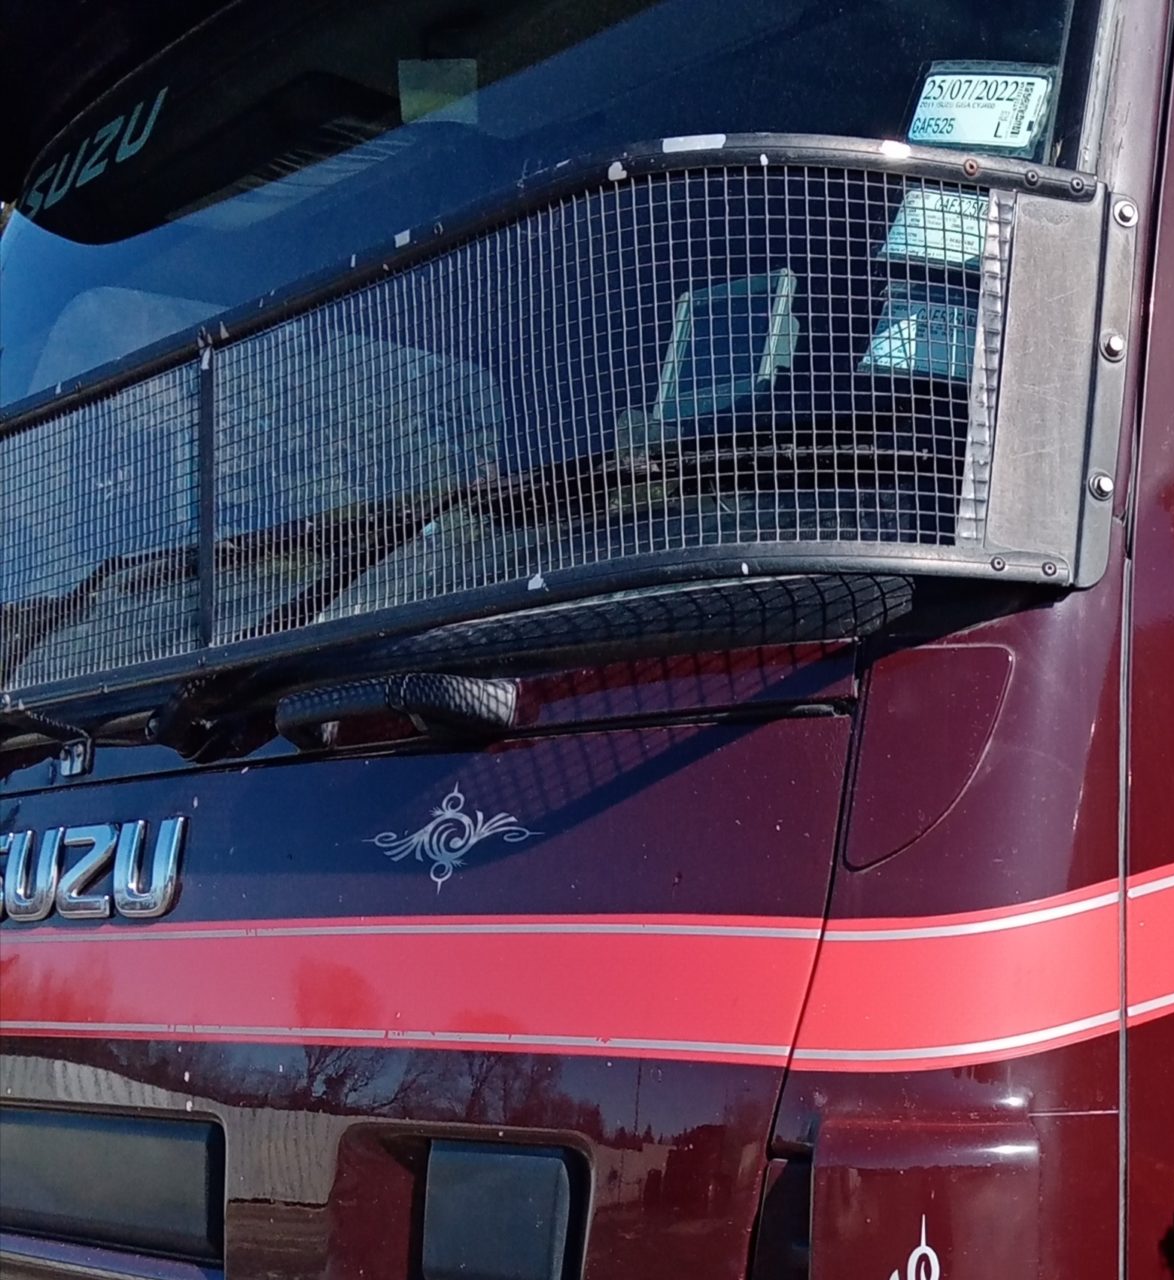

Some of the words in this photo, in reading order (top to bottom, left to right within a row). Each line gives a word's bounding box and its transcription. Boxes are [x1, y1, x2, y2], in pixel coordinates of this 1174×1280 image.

[922, 79, 1019, 101] 25/07/2022
[912, 117, 956, 134] GAF525
[0, 815, 189, 922] UZU
